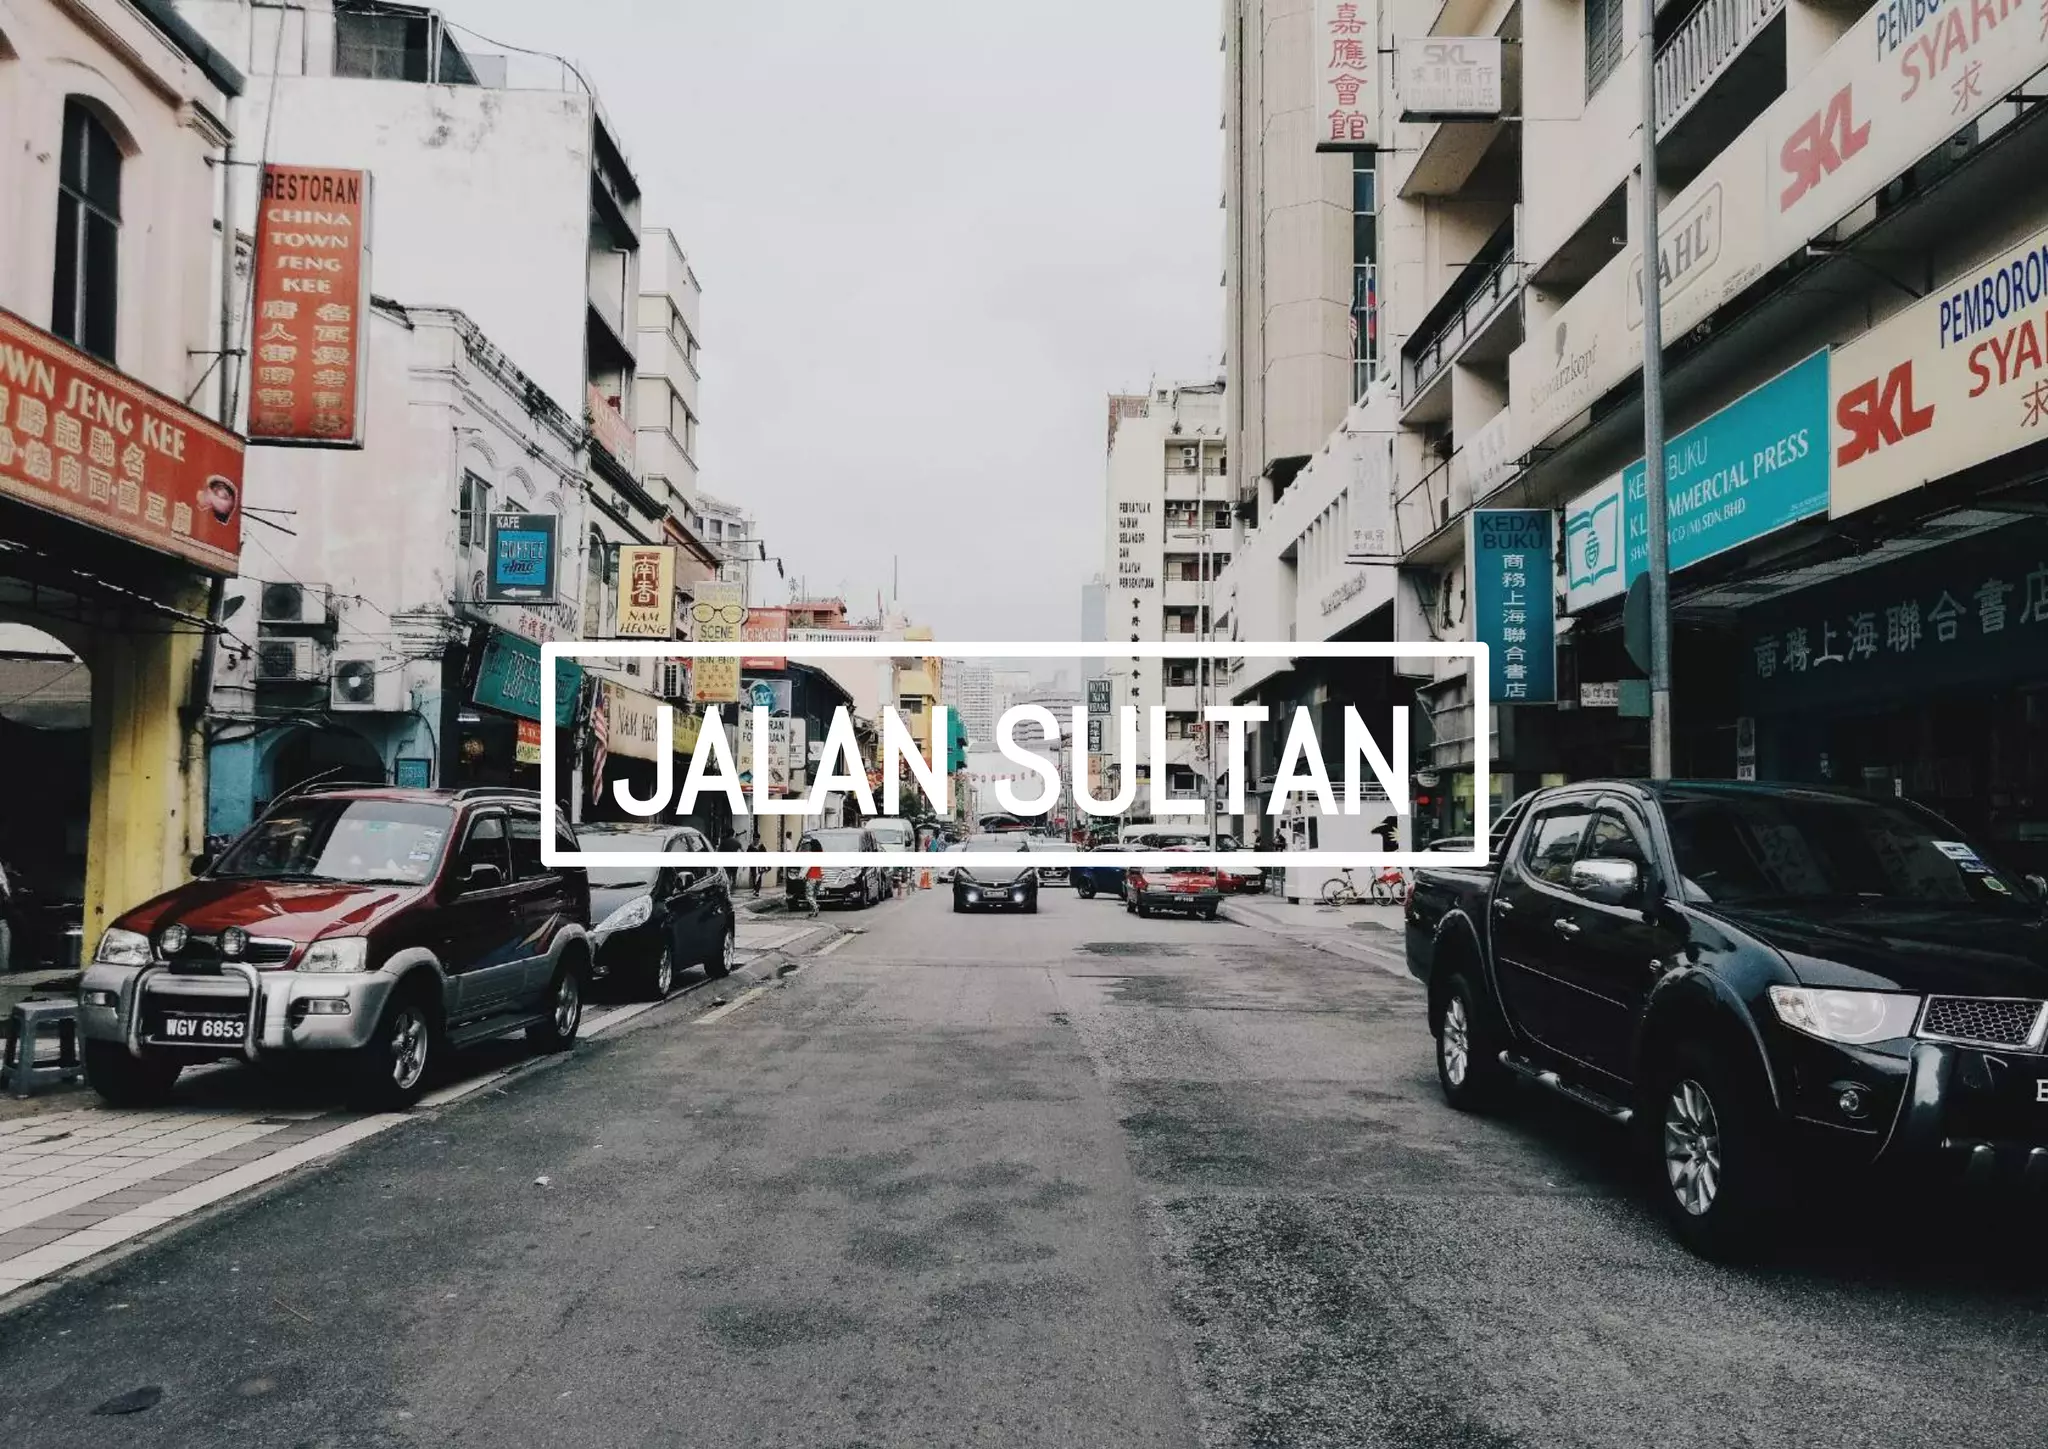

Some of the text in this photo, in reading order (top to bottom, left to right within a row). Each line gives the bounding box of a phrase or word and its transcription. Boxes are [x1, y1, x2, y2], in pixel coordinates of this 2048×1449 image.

[1424, 44, 1478, 66] SKL
[1328, 3, 1369, 141] 嘉應會館
[1780, 82, 1872, 214] SKL
[263, 172, 359, 205] RESTORAN
[267, 208, 353, 227] CHINA
[270, 231, 349, 249] TOWN
[283, 277, 332, 295] KEE
[1940, 245, 2048, 350] PEMBORO
[1837, 308, 2048, 468] SKL SYA
[143, 413, 187, 464] KEE
[1668, 437, 1708, 480] BUKU
[1753, 428, 1810, 480] PRESS
[496, 516, 520, 529] KAFE
[500, 541, 544, 560] COFFEE
[1483, 532, 1544, 550] BUKU
[630, 556, 659, 604] 南香
[627, 610, 660, 622] NAM
[1501, 554, 1528, 698] 商務上海聯合書店
[620, 622, 667, 635] HEONG
[700, 624, 734, 640] SCENE
[166, 1018, 245, 1038] WGV 6853
